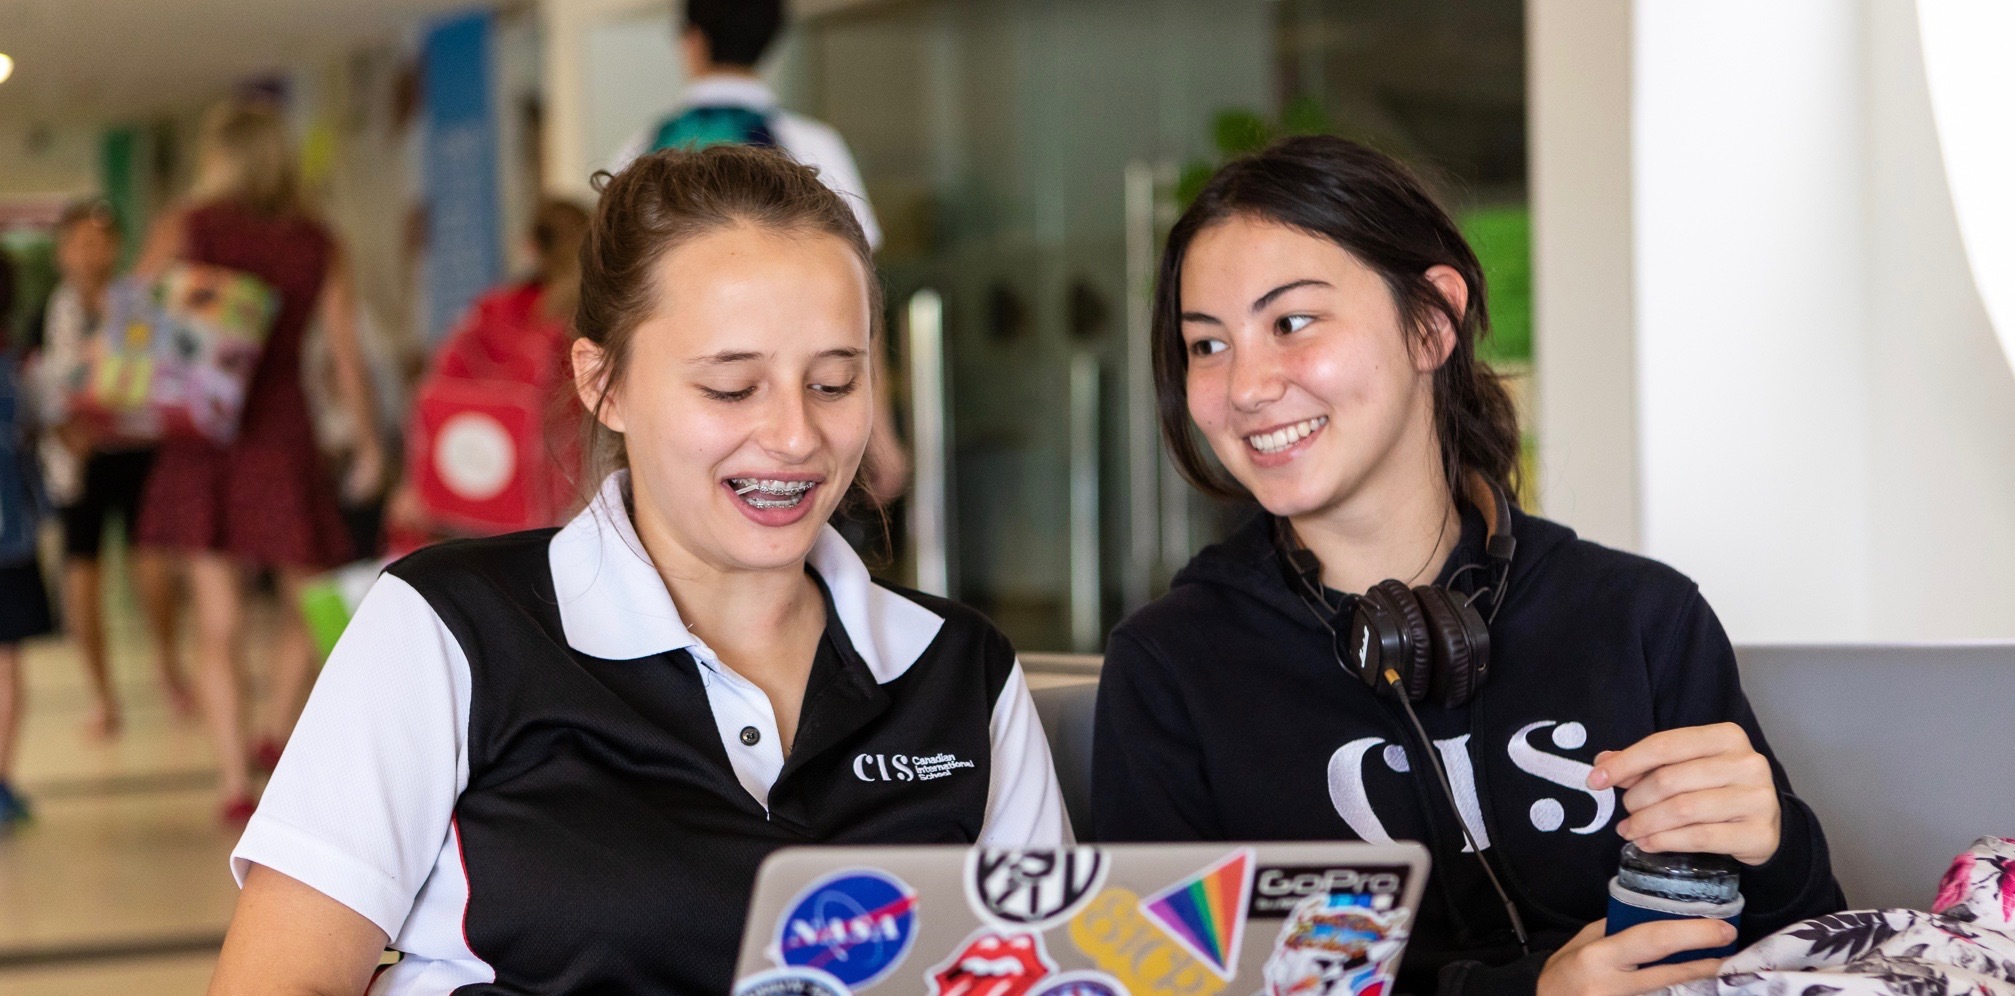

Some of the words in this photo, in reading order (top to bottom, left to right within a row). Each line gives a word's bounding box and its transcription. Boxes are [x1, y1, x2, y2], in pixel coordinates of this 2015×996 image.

[853, 754, 914, 781] CIS
[912, 752, 956, 766] Canadian
[915, 760, 975, 774] International
[918, 769, 952, 781] School
[1327, 720, 1616, 853] CIS
[1258, 868, 1400, 895] GoPro
